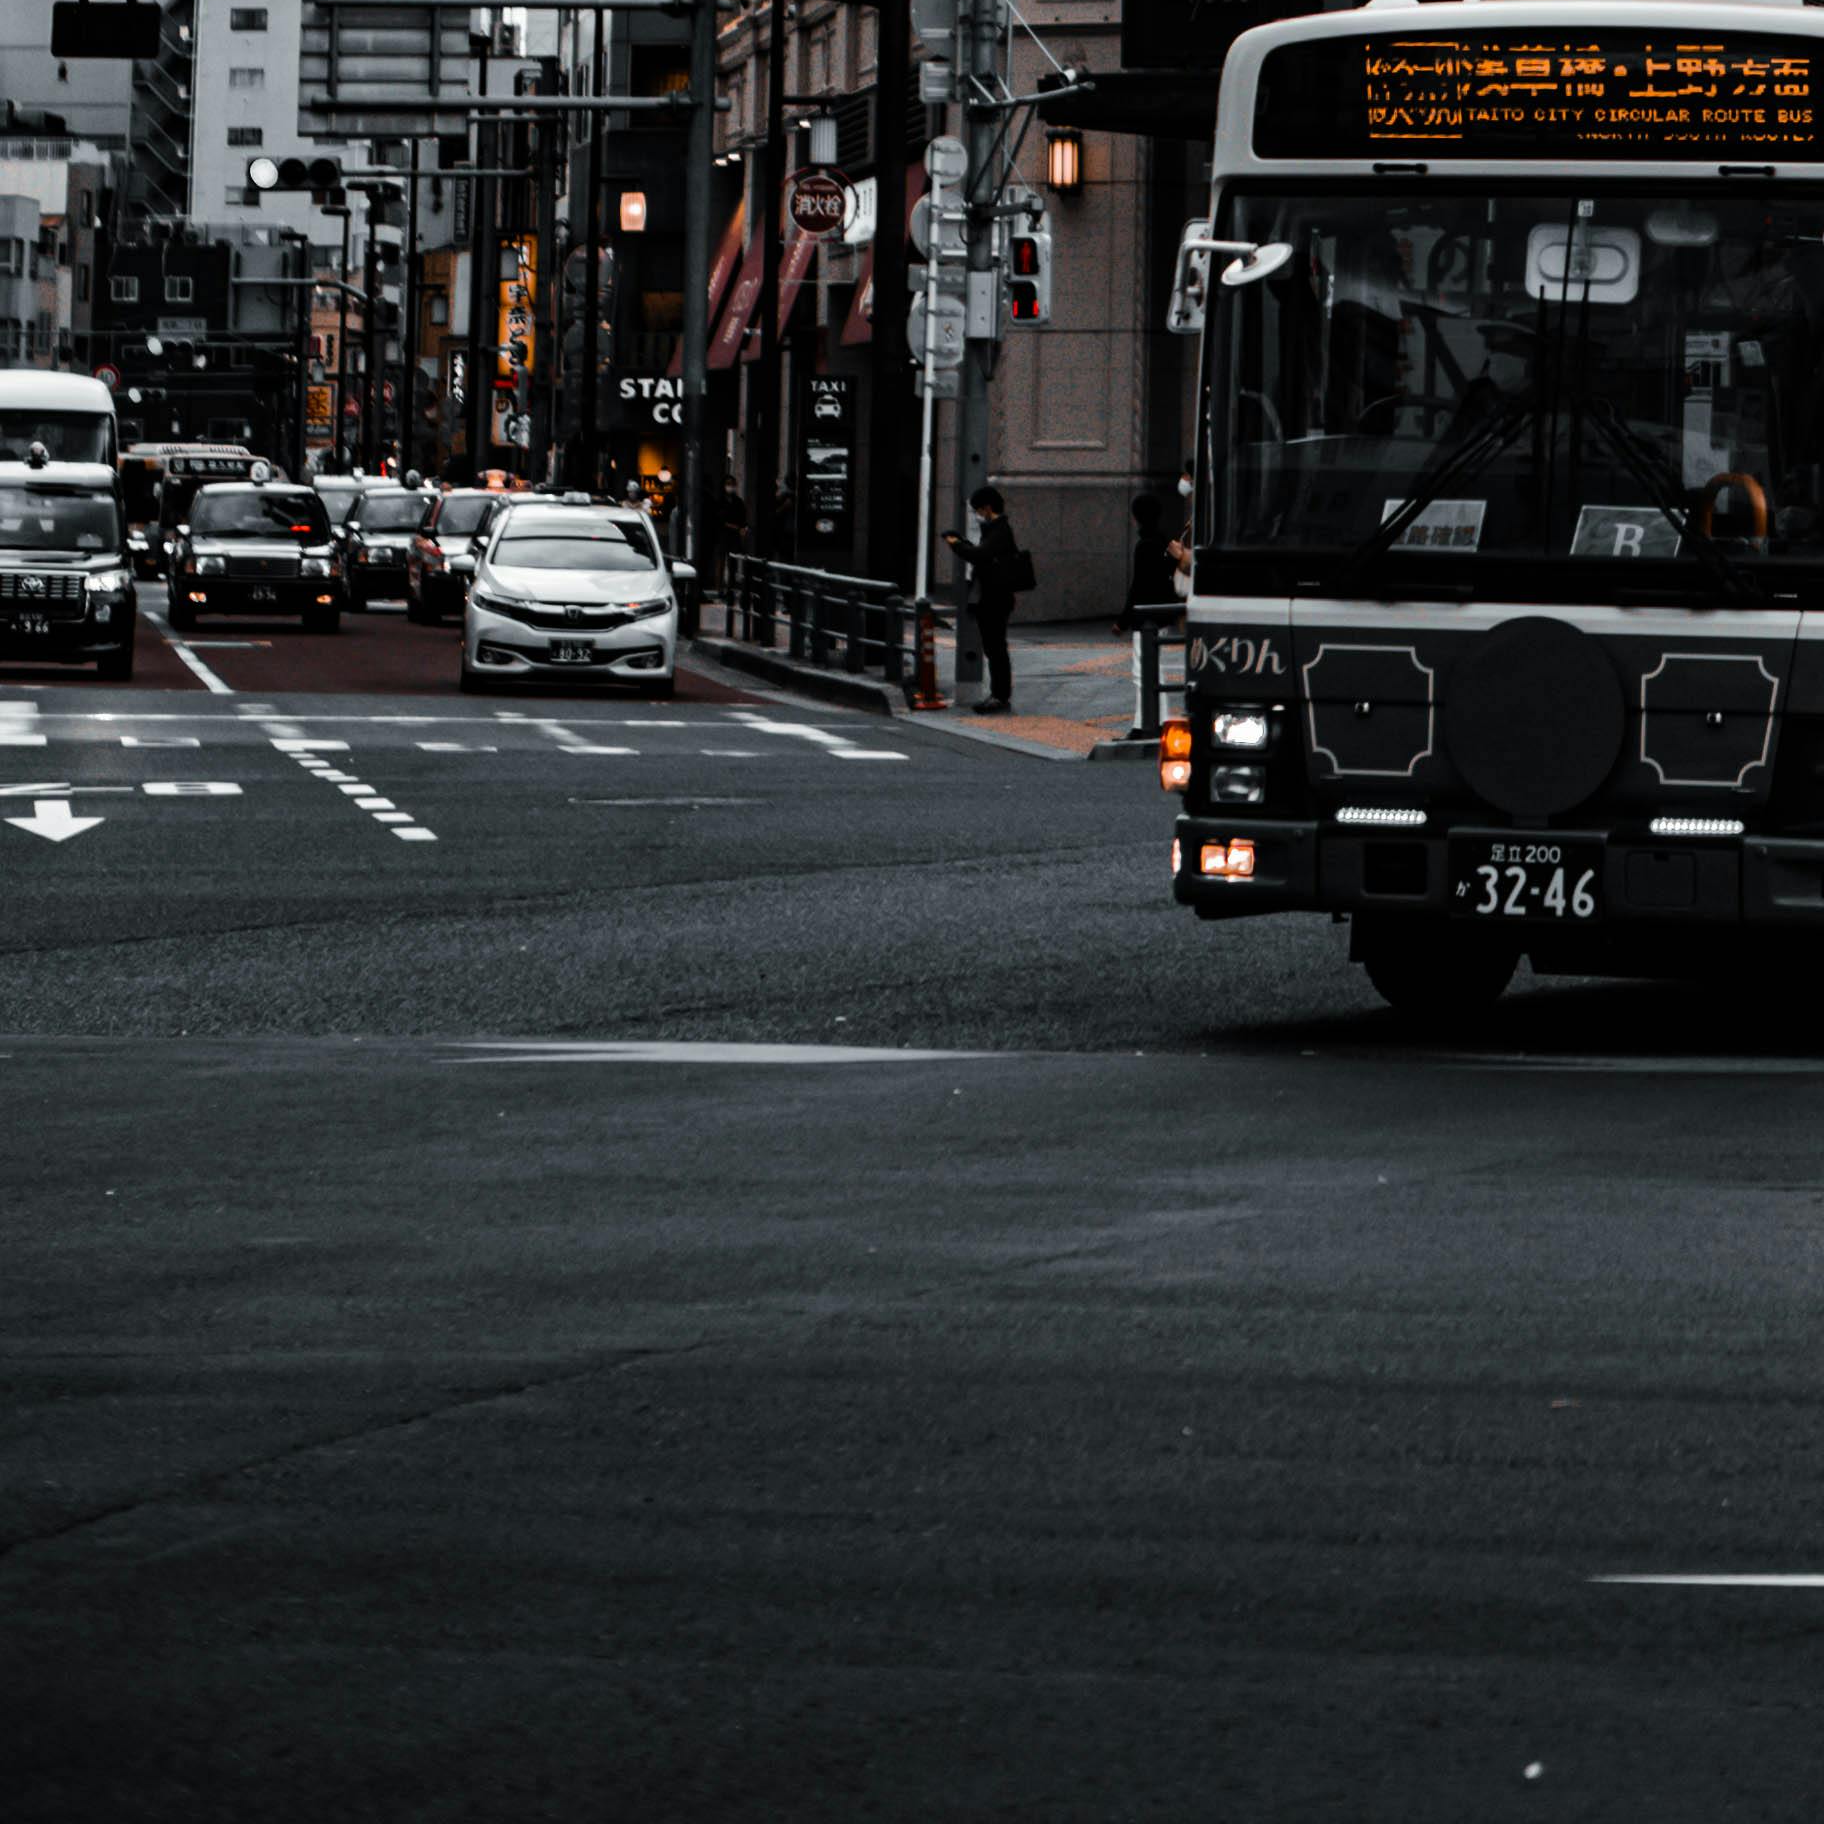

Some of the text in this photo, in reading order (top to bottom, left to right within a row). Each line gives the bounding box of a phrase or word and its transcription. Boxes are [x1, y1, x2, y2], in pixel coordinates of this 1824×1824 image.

[1467, 108, 1814, 124] TAITO CITY CIRCULAR ROUTE BUS
[795, 192, 842, 216] 消火栓
[810, 379, 847, 393] TAXI
[1189, 637, 1286, 675] めぐりん
[1476, 865, 1595, 917] 32-46
